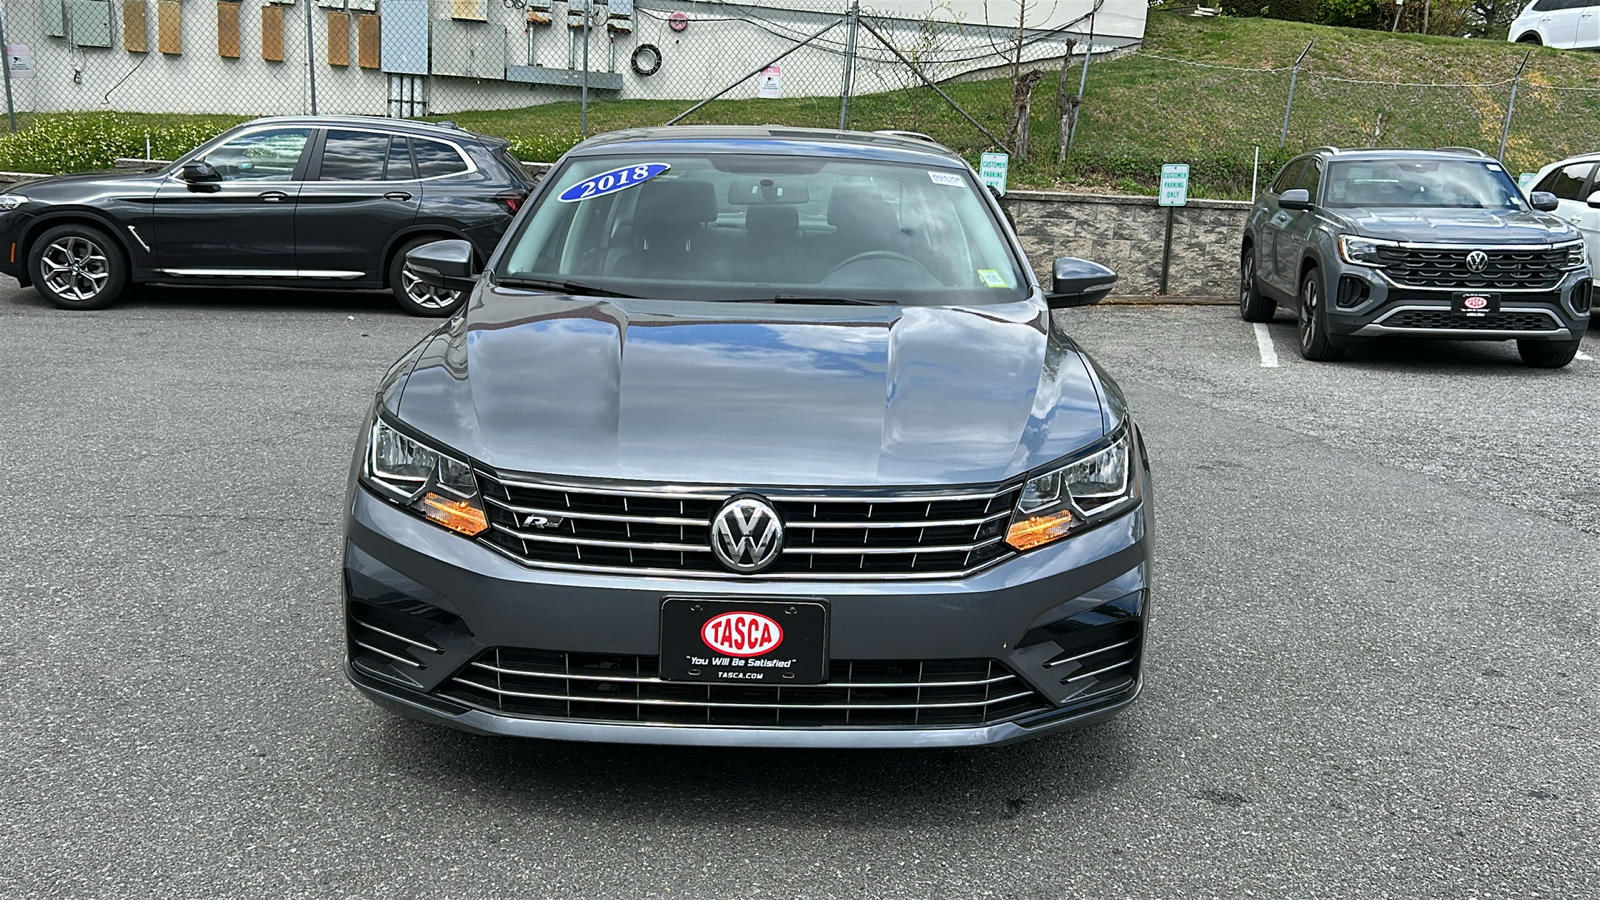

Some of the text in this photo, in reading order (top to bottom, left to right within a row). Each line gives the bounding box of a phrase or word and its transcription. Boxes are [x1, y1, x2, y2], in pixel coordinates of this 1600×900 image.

[983, 161, 1006, 169] CUSTOMER
[983, 171, 1003, 179] PARKING
[580, 165, 648, 198] 2018
[711, 616, 772, 650] TASCA
[712, 657, 730, 666] Will
[731, 658, 745, 667] Be
